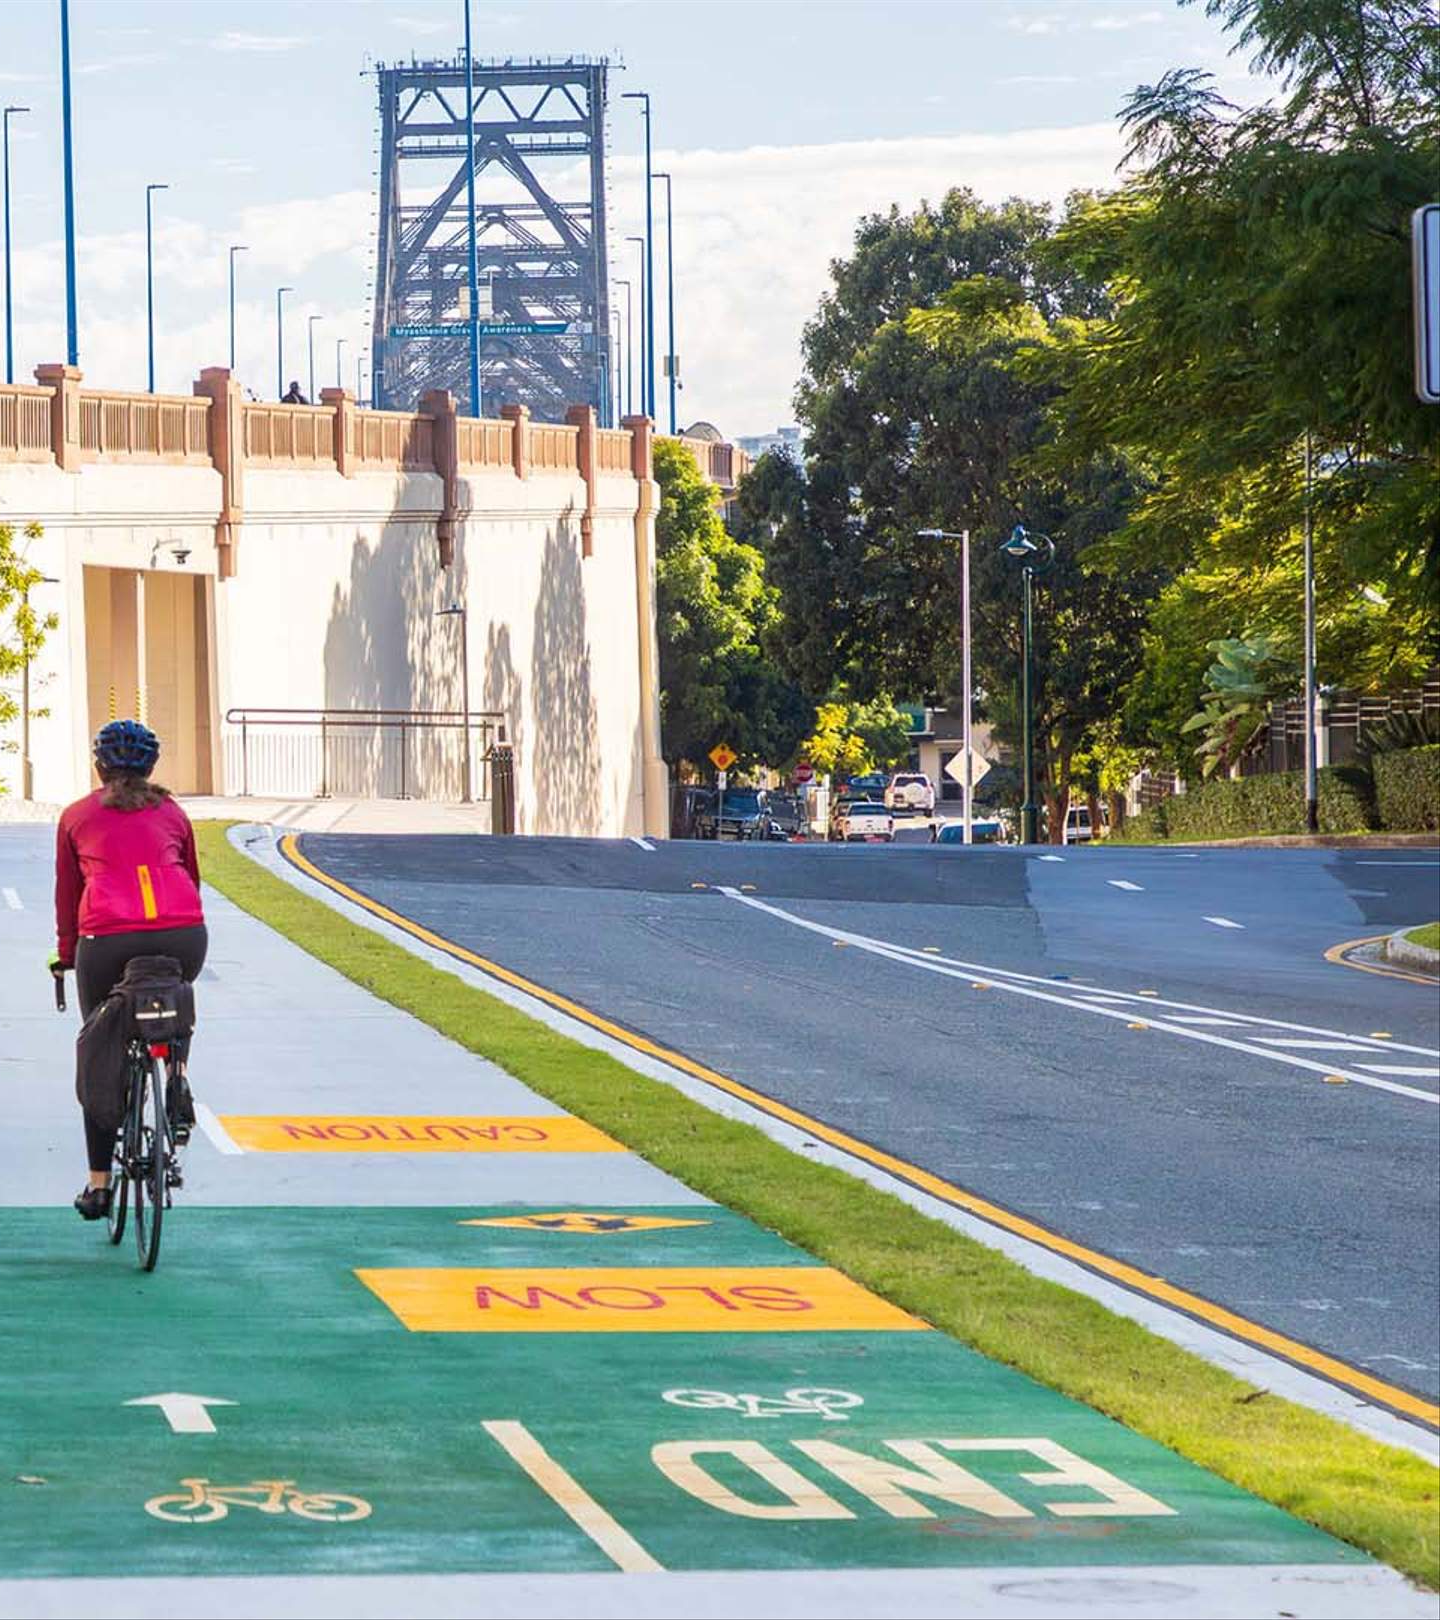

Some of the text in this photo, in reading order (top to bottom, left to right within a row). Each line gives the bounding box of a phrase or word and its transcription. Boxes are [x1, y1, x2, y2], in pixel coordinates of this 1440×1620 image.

[395, 325, 533, 336] Myasthenia Grav Awareness
[280, 1124, 549, 1141] CAUTION
[474, 1285, 814, 1311] SLOW
[650, 1437, 1179, 1521] END
